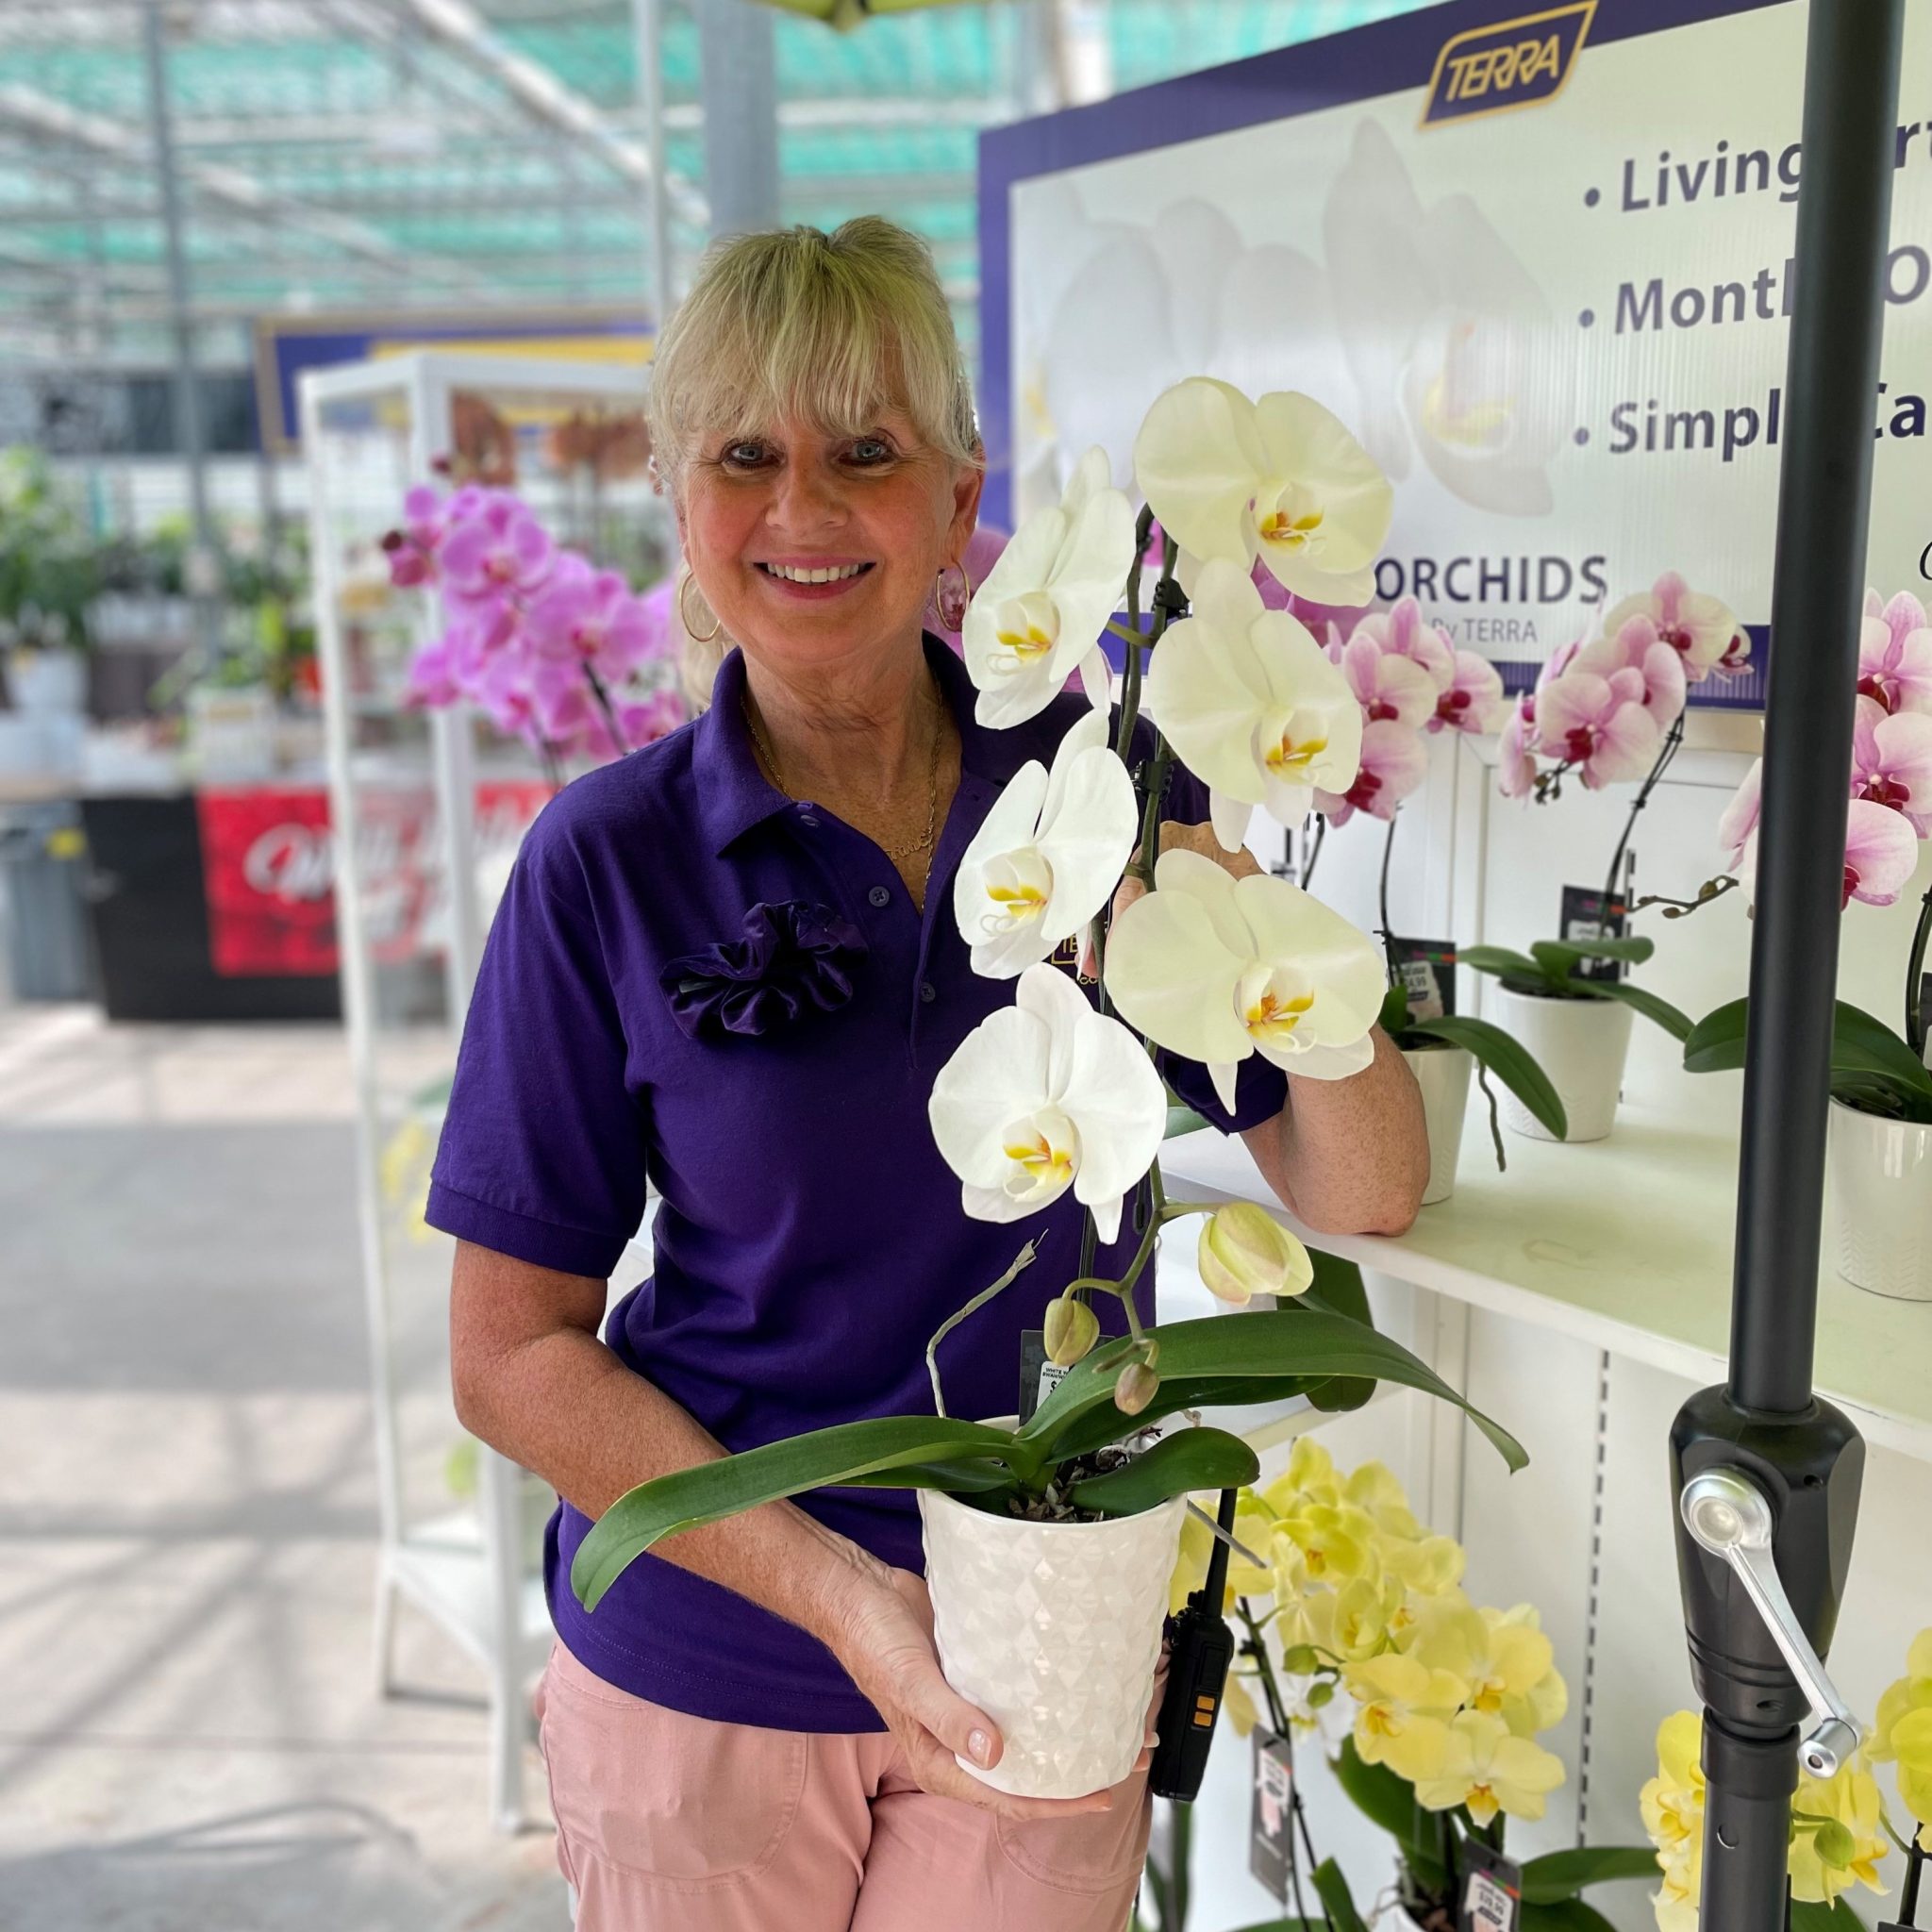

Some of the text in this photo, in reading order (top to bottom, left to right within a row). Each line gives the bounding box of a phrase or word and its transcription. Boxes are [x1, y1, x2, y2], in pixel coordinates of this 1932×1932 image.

[1446, 34, 1559, 103] TERRA
[1622, 140, 1803, 212] Living
[1614, 258, 1796, 335] Mont
[1608, 388, 1781, 462] Simpl
[1374, 556, 1607, 605] ORCHIDS
[1463, 618, 1539, 643] TERRA
